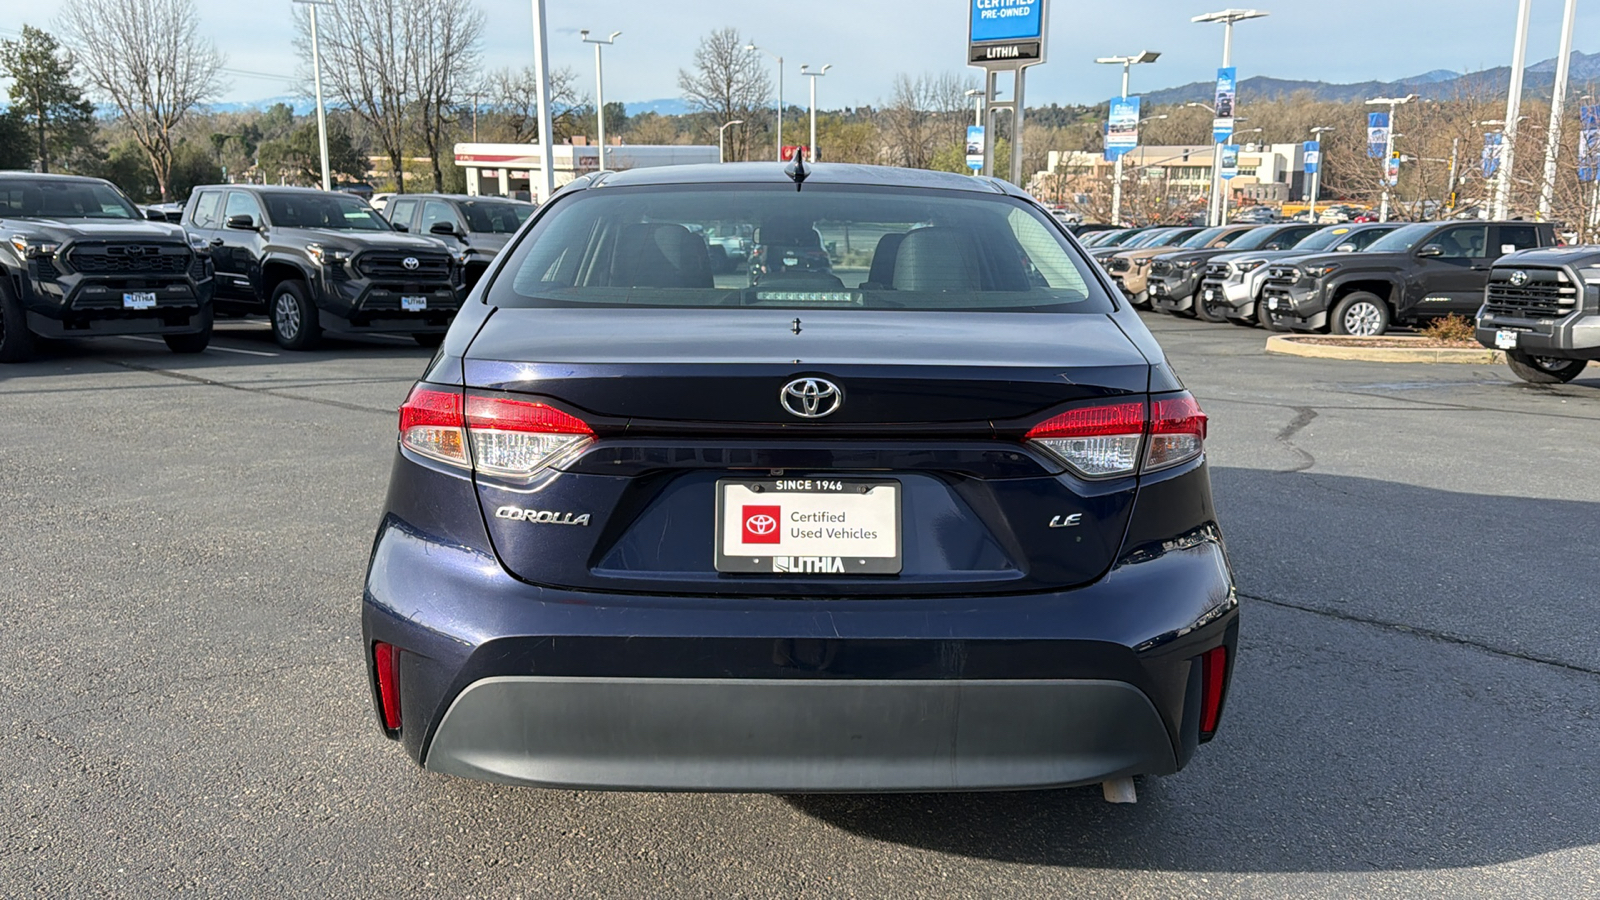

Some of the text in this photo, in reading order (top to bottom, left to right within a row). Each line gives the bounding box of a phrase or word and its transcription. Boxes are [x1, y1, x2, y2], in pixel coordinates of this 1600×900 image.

[981, 6, 1030, 19] PRE-OWNED
[986, 46, 1019, 58] LITHIA
[776, 480, 843, 491] SINCE 1946
[495, 506, 591, 526] COROLLA
[790, 511, 846, 522] Certified
[1049, 513, 1082, 527] LE
[790, 527, 878, 540] Used Vehicles
[790, 556, 846, 573] LITHIA
